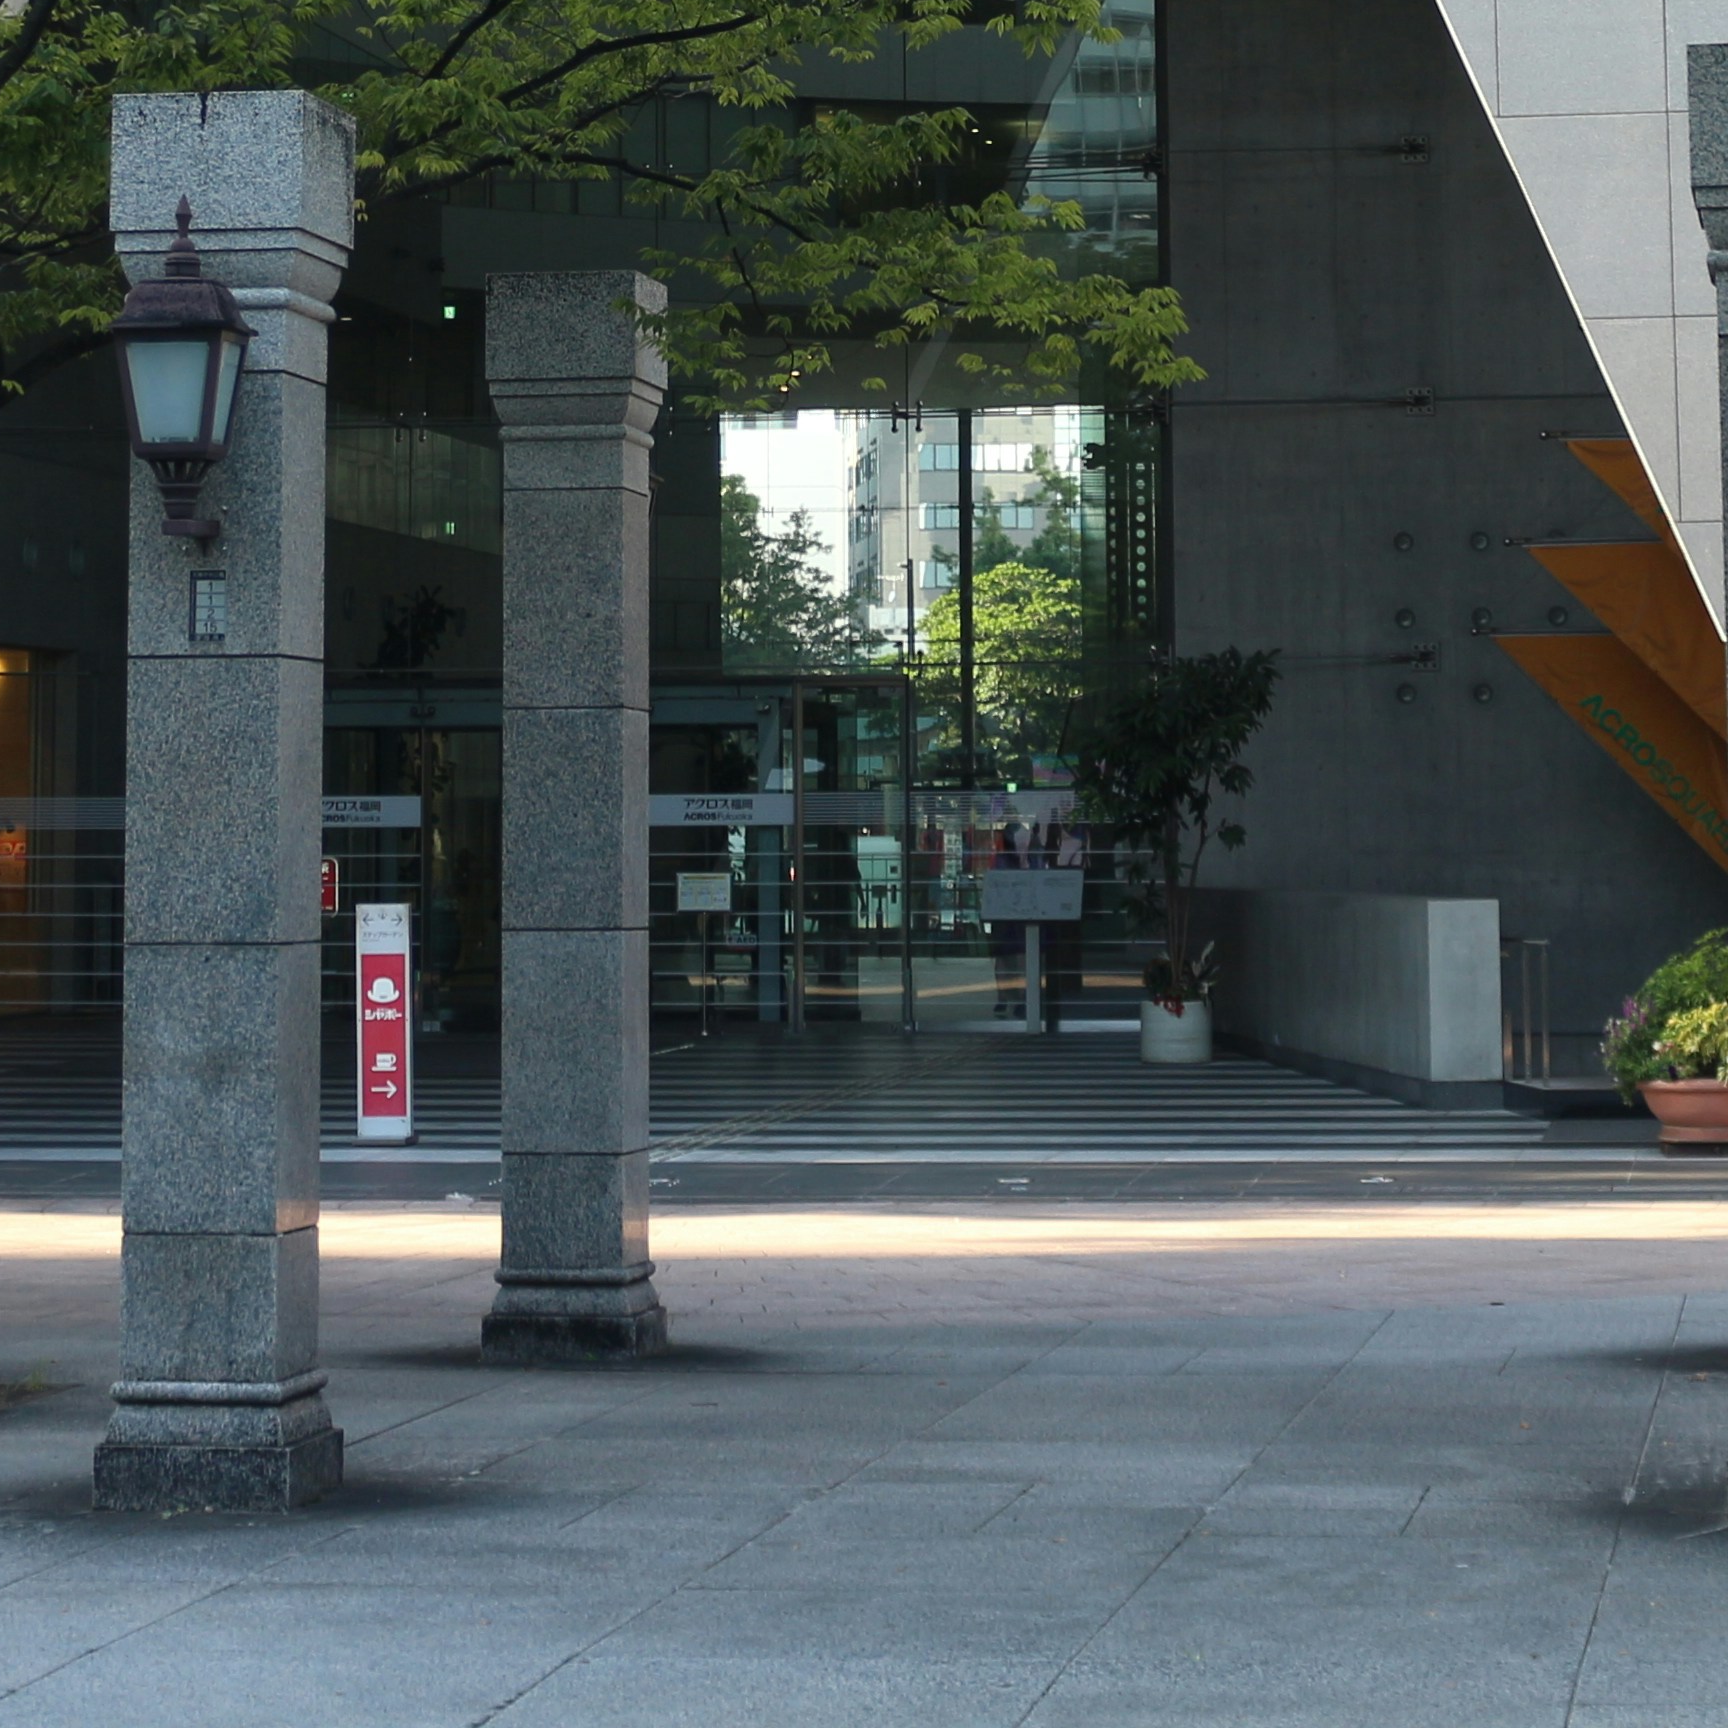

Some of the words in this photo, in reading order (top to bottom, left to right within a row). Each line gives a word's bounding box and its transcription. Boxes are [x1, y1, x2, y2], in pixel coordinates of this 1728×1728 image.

[322, 800, 382, 812] クロス福岡
[684, 798, 753, 810] アクロス福岡
